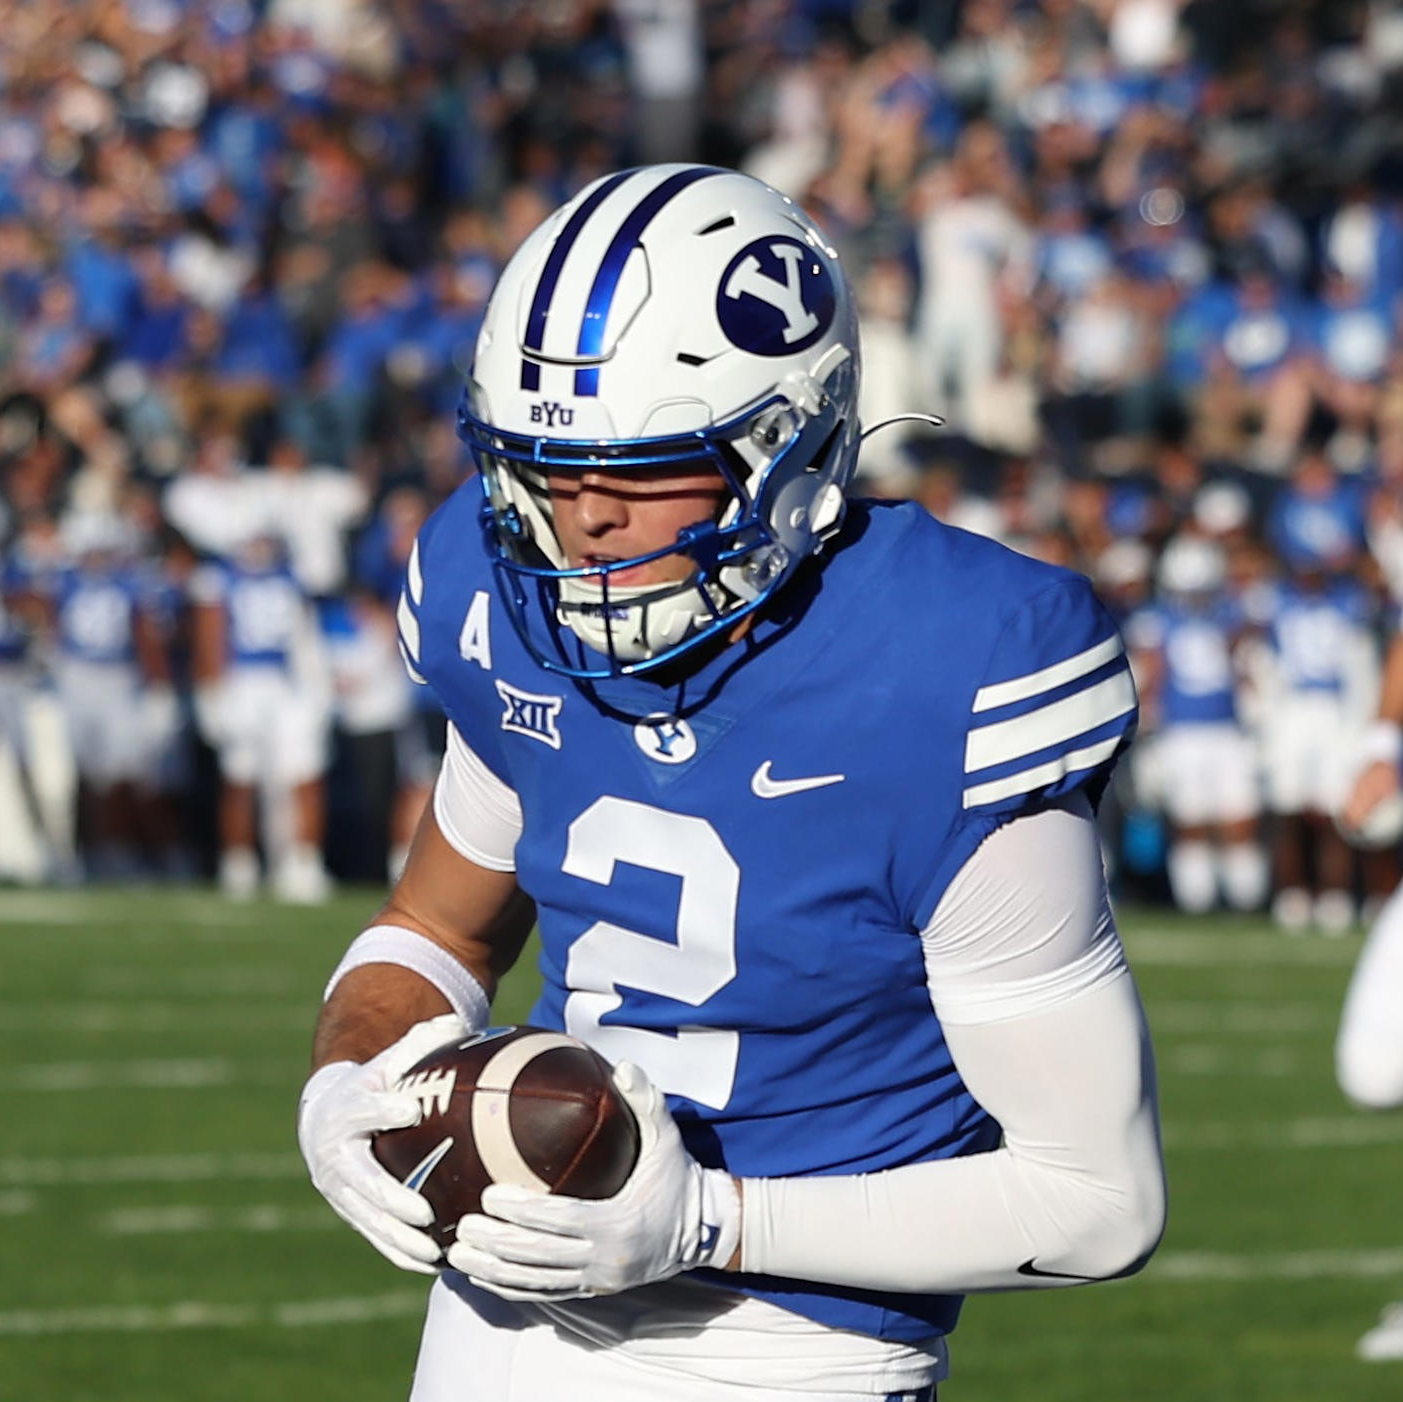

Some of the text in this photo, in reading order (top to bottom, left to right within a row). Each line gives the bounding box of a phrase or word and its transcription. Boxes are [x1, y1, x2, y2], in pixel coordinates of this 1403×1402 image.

[724, 242, 819, 344] Y
[530, 401, 574, 428] BYU
[561, 795, 741, 1112] 2
